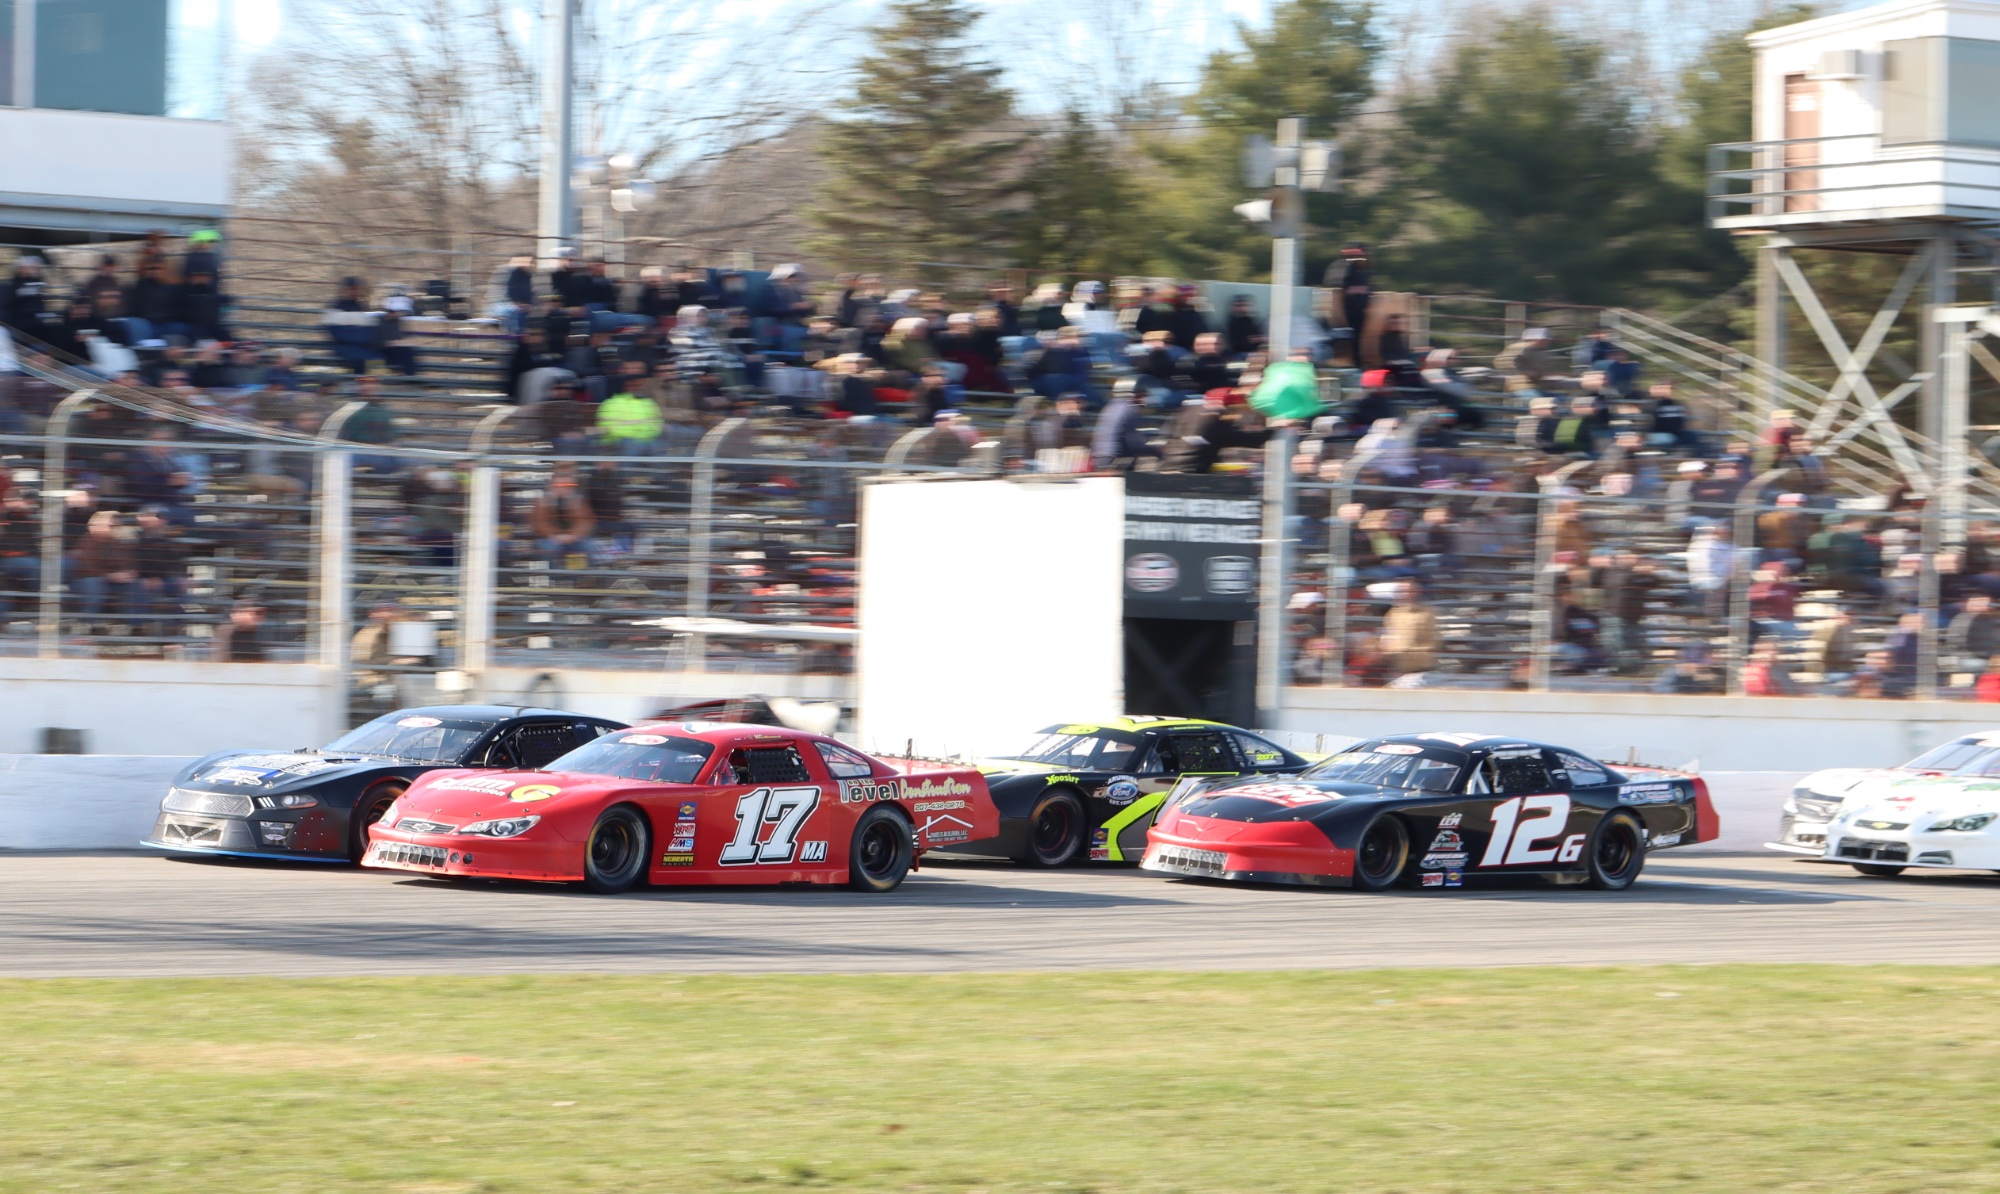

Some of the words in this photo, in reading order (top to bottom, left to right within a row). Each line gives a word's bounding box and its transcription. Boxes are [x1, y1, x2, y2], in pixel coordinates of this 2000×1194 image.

[1045, 774, 1080, 785] Hoosier
[837, 779, 900, 803] level
[900, 776, 971, 799] Construction
[1112, 785, 1132, 797] Ford
[718, 786, 822, 867] 17
[799, 841, 828, 863] MA
[1478, 793, 1571, 868] 12
[669, 838, 694, 848] HMS
